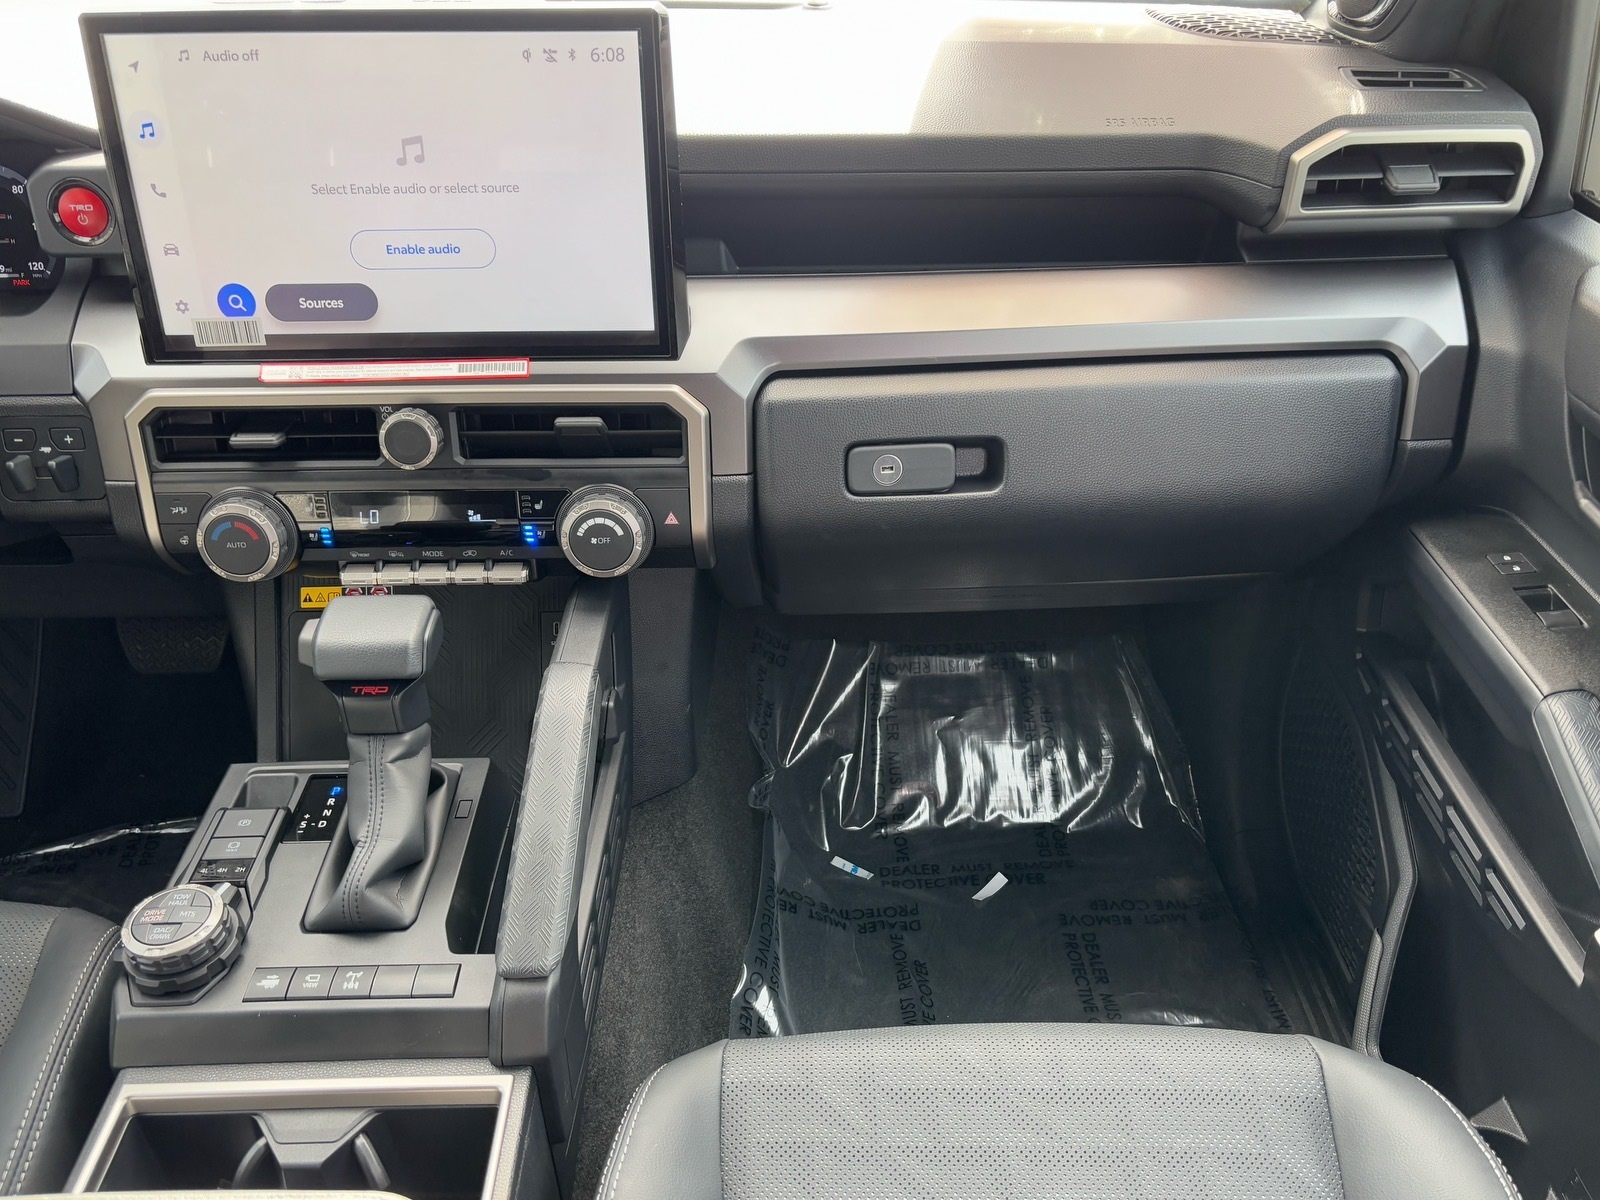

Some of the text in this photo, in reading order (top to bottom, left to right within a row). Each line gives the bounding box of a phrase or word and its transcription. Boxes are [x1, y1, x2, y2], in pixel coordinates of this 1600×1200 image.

[203, 49, 260, 61] Audio off
[590, 47, 625, 62] 6:08
[1131, 117, 1176, 127] AIRBAG
[12, 185, 24, 194] 80
[311, 183, 520, 195] Select Enable audio or select source
[69, 204, 94, 212] TRD
[386, 243, 461, 255] Enable audio
[28, 262, 44, 271] 120
[299, 297, 345, 309] Sources
[227, 541, 247, 549] AUTO
[597, 537, 611, 545] OFF
[500, 549, 514, 557] A/C
[351, 686, 390, 695] TRD
[1020, 674, 1038, 743] REMOVE
[887, 751, 904, 793] MUST
[331, 786, 341, 796] P
[327, 798, 336, 806] R
[323, 809, 332, 817] N
[299, 820, 327, 829] S D
[879, 863, 941, 878] DEALER
[951, 862, 993, 874] MUST
[1003, 859, 1075, 872] REMOVE
[881, 872, 981, 890] PROTECTIVE
[820, 900, 920, 921] PROTECTIVE
[1088, 899, 1149, 912] COVER
[144, 908, 168, 916] DRIVE
[807, 907, 848, 931] MUST
[1059, 913, 1134, 927] REMOVE
[857, 919, 922, 934] DEALER
[889, 932, 913, 991] REMOVE
[1080, 932, 1110, 985] DEALER
[1061, 931, 1100, 1014] PROTECTIVE
[913, 959, 935, 1009] COVER
